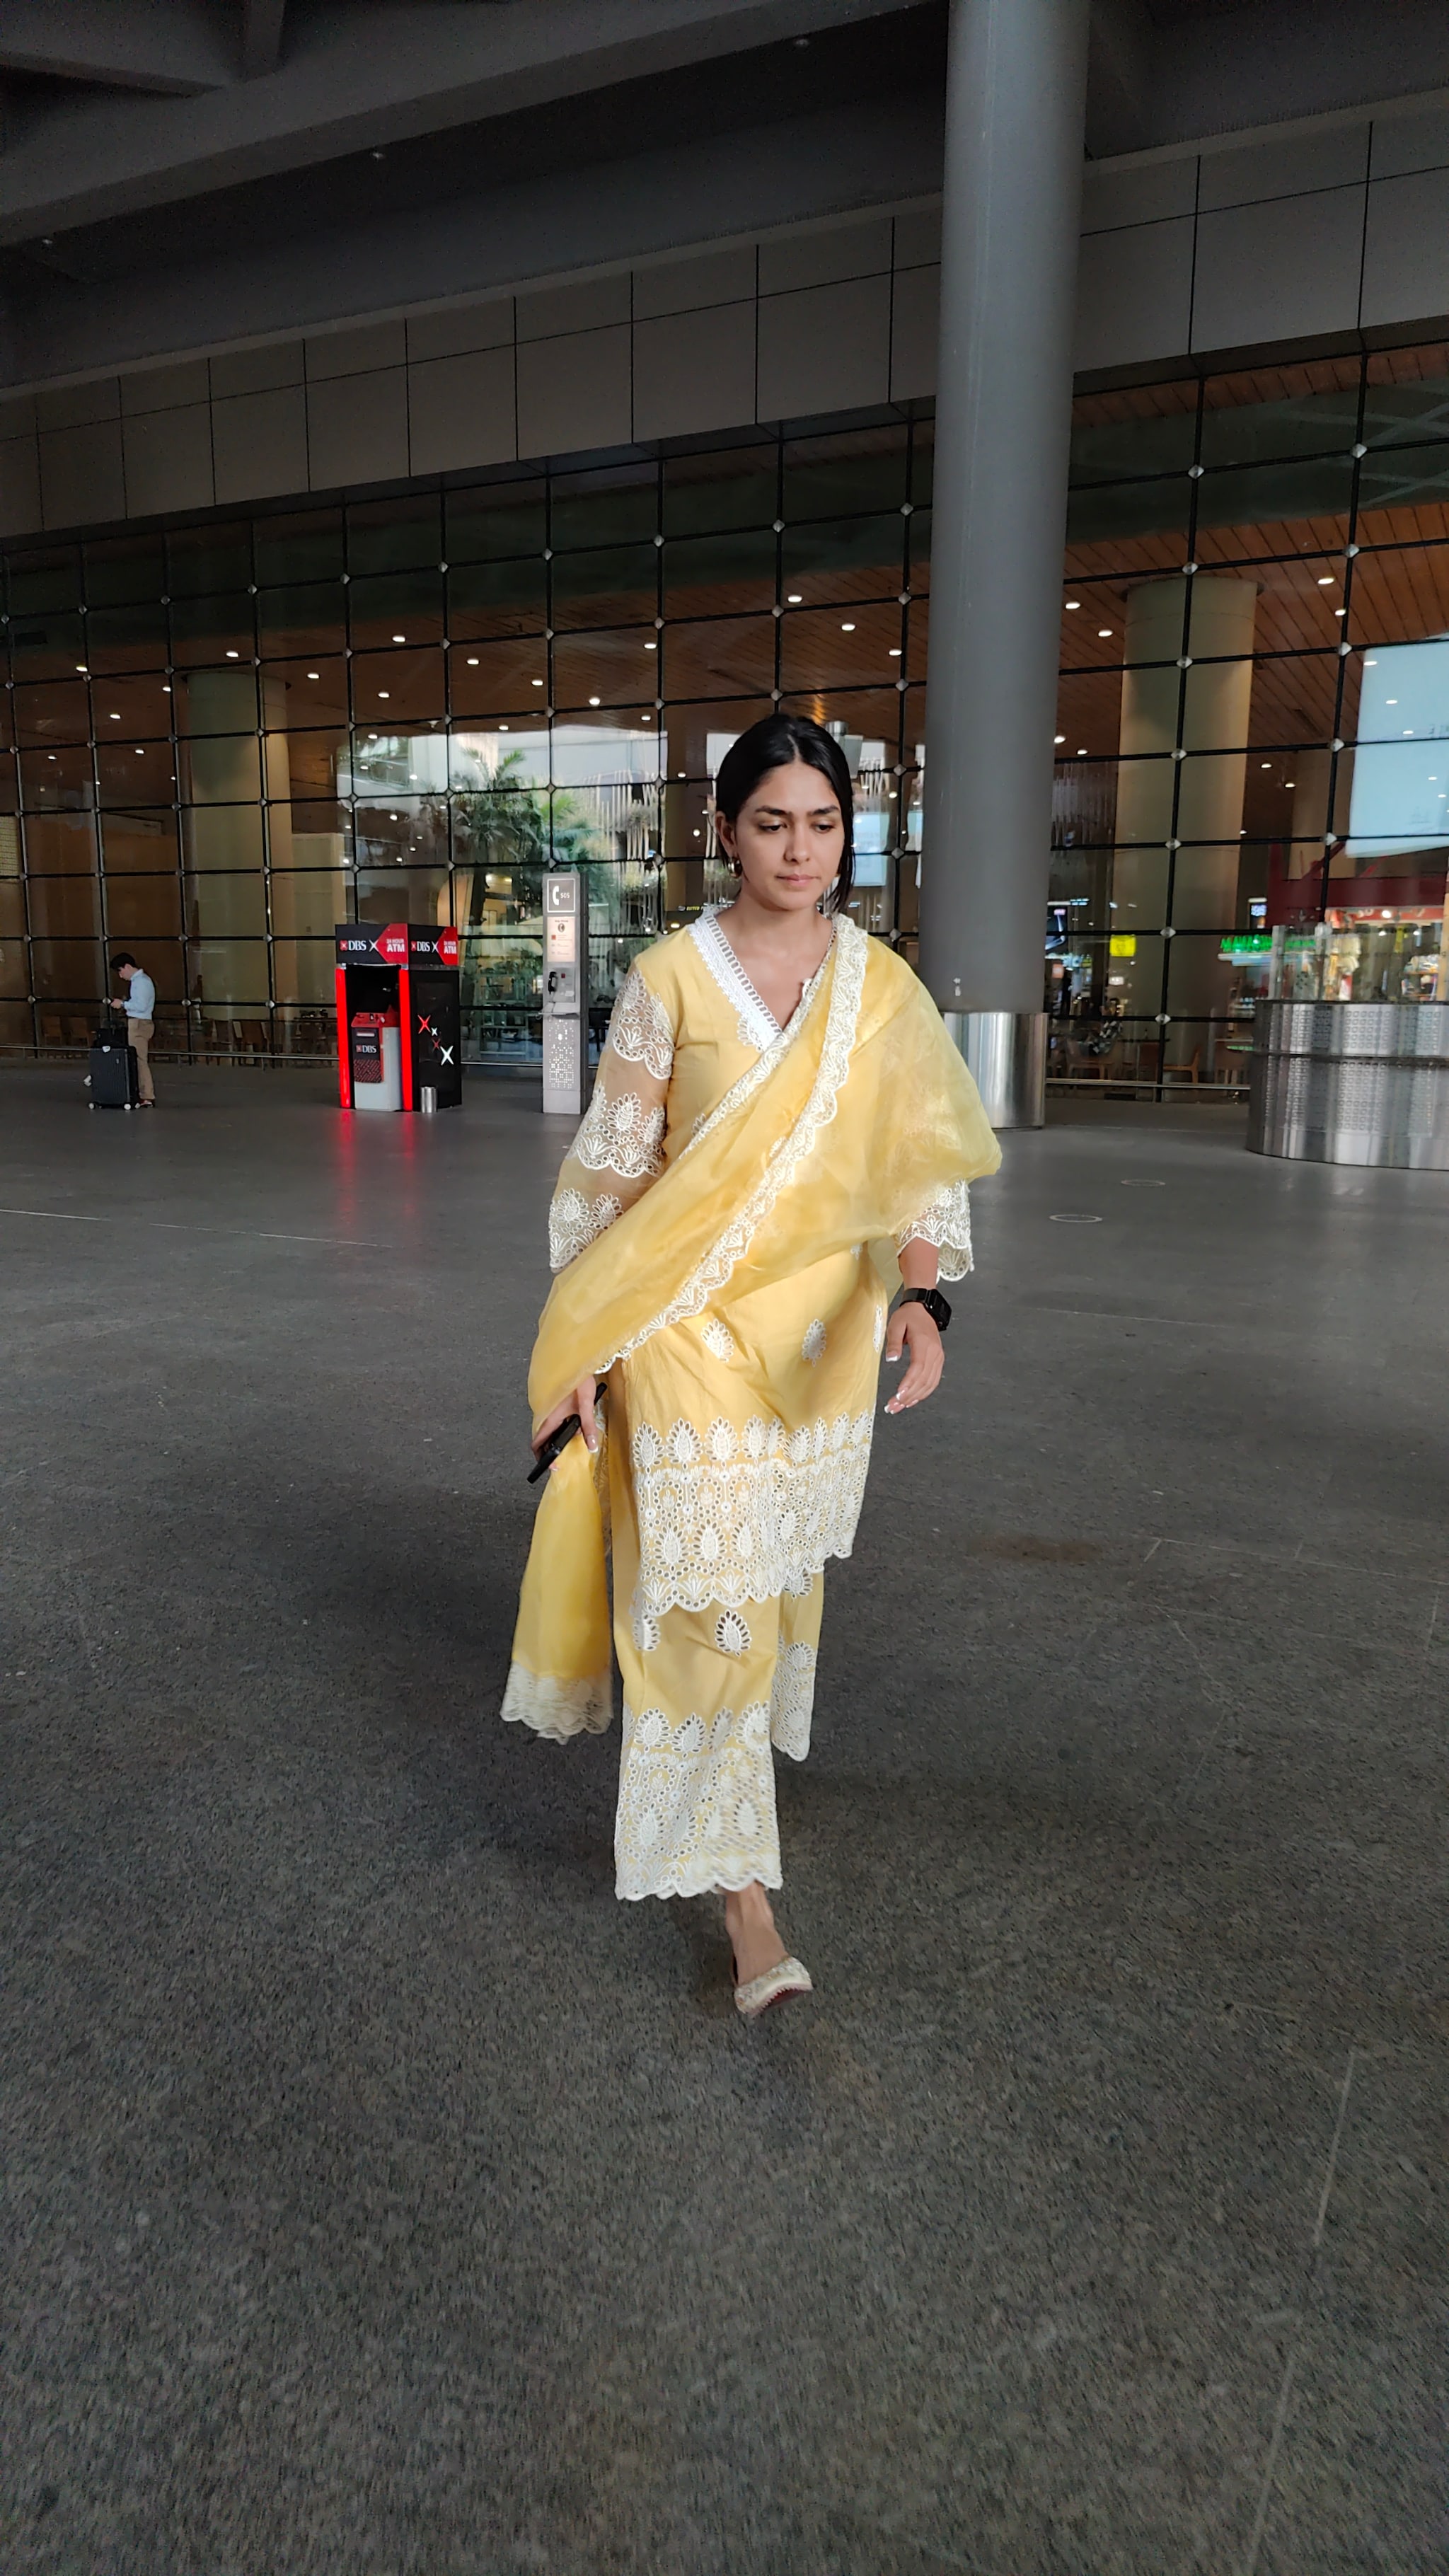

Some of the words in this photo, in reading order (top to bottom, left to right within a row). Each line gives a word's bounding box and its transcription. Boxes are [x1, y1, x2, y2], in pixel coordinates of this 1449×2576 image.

[348, 940, 366, 951] DBS
[386, 944, 405, 952] ATM
[417, 941, 430, 952] DBS
[444, 945, 457, 954] ATM
